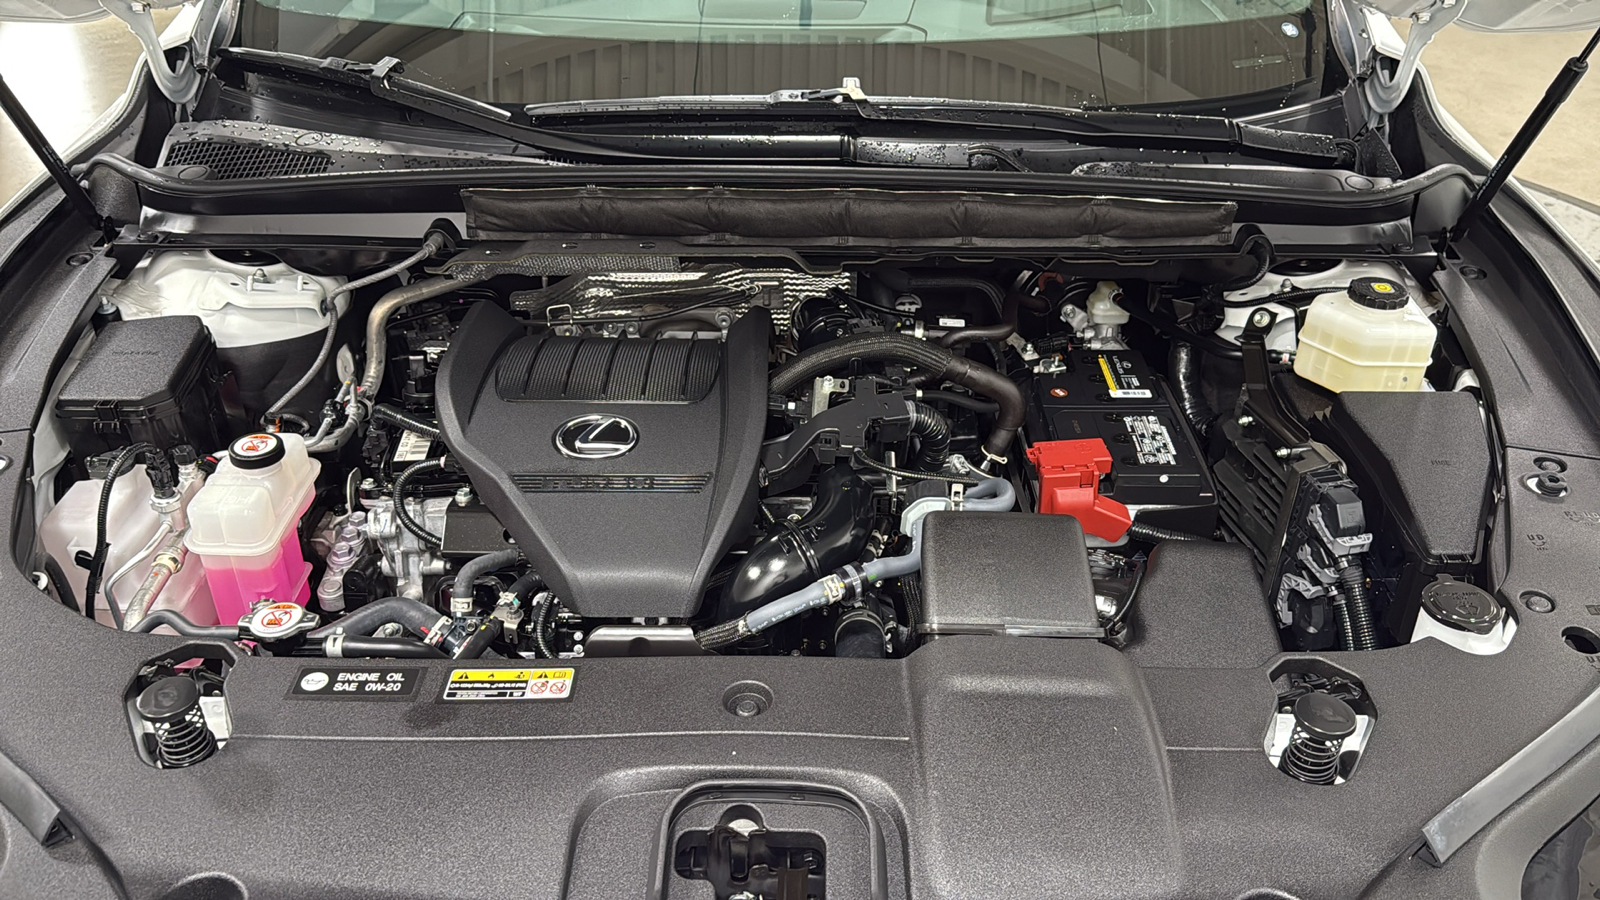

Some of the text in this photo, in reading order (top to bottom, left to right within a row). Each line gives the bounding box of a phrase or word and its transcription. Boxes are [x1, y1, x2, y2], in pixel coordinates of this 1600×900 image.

[1112, 355, 1124, 374] LEXUS
[337, 672, 405, 681] ENGINE OIL
[333, 682, 402, 692] SAE 0W-20
